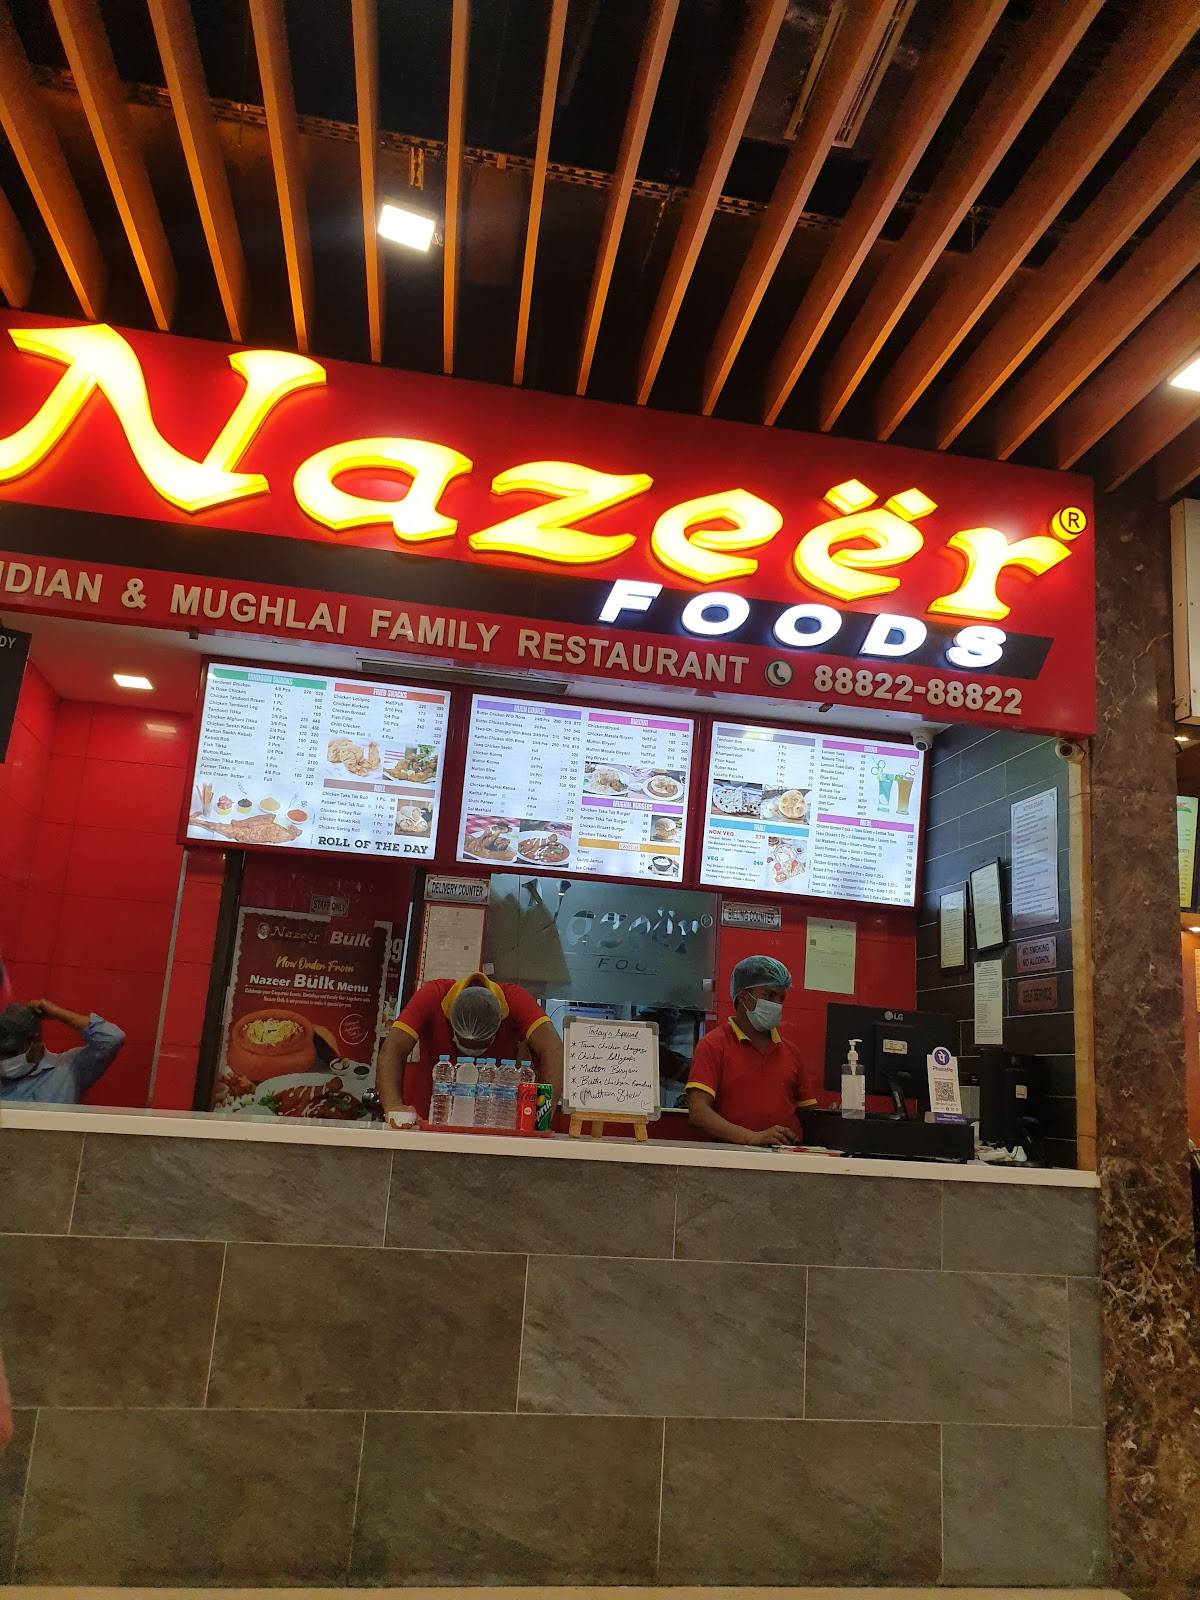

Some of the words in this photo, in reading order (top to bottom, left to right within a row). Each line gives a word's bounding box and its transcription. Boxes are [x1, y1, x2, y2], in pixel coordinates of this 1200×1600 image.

[599, 579, 1007, 668] FOODS
[0, 561, 103, 603] DIAN
[121, 578, 147, 610] &
[169, 584, 348, 635] MUGHLAI
[370, 609, 500, 652] FAMILY
[517, 629, 749, 684] RESTAURANT
[814, 664, 1023, 715] 88822-88822
[372, 687, 387, 696] FRIED
[387, 689, 408, 699] SNACKS
[317, 835, 350, 847] ROLL
[354, 839, 371, 849] OF
[374, 841, 400, 852] THE
[403, 843, 428, 854] DAY
[432, 882, 457, 895] DELIVERY
[459, 885, 484, 897] COUNTER
[276, 955, 297, 968] Now
[299, 957, 326, 971] Order
[327, 960, 354, 973] From
[250, 974, 291, 987] Nazeer
[337, 981, 368, 993] Menu
[894, 1012, 904, 1020] LG
